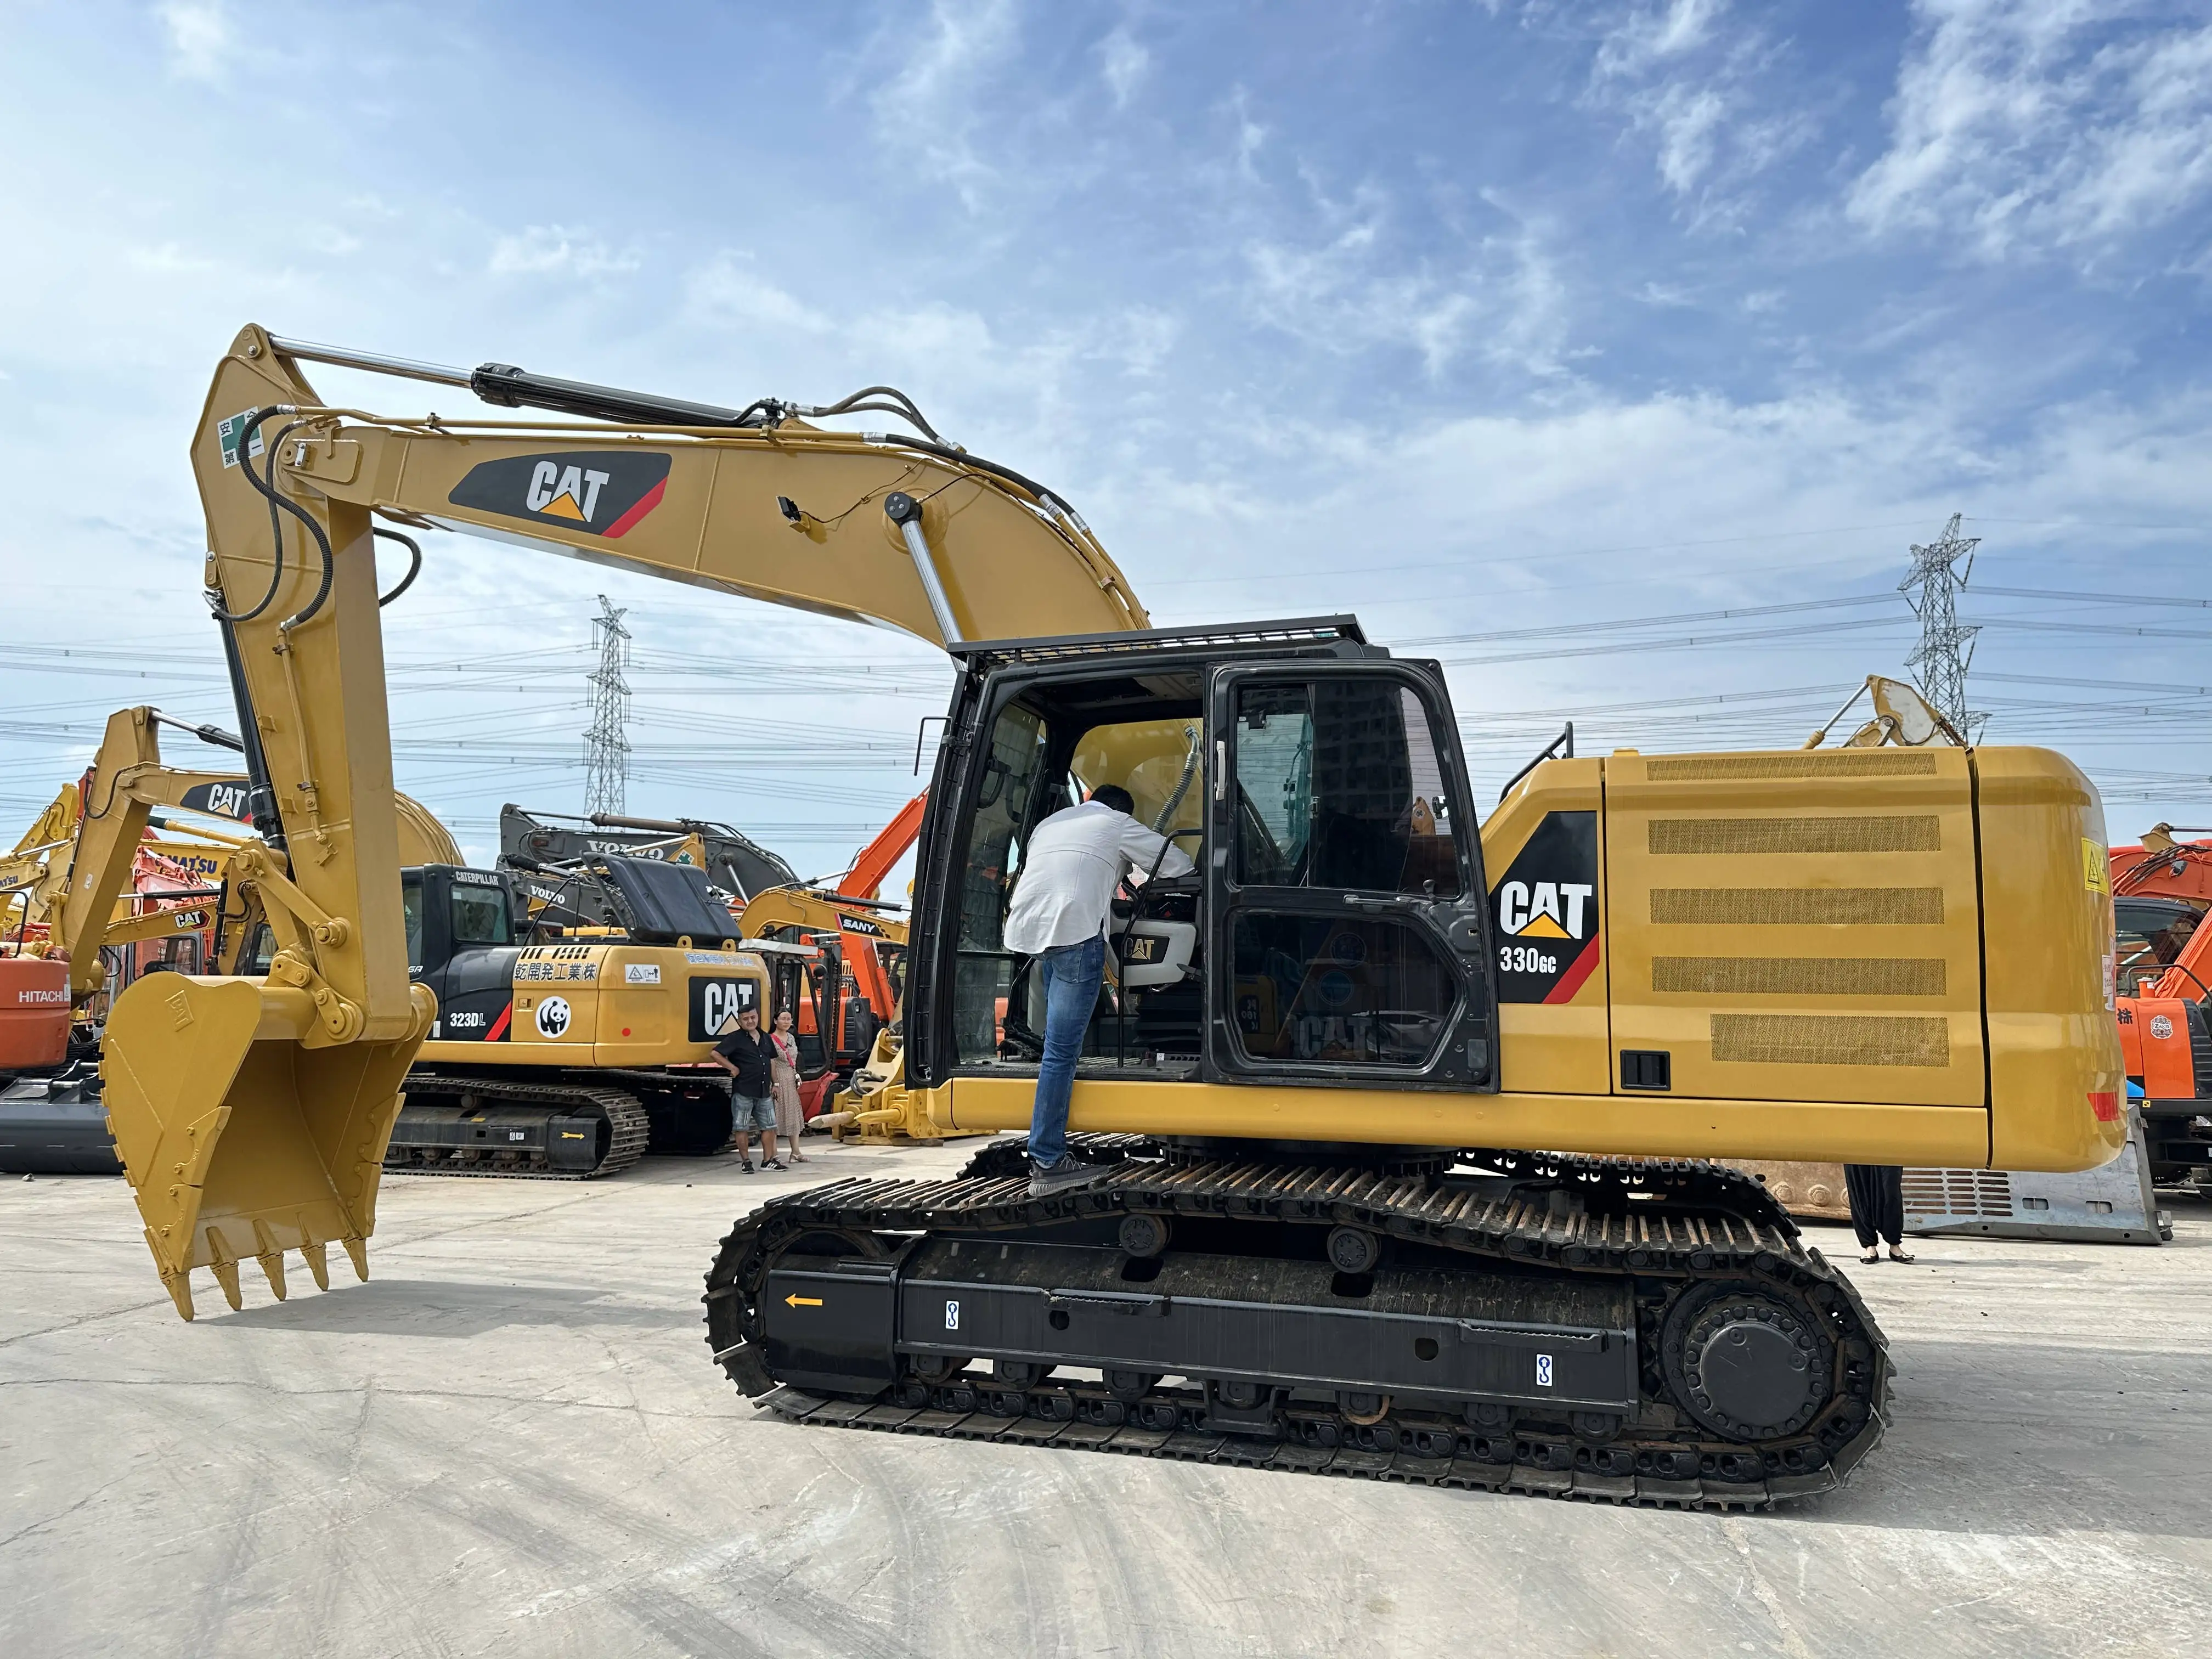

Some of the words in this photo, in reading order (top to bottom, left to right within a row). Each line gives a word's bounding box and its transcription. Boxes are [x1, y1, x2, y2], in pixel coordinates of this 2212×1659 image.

[526, 461, 610, 523] CAT
[208, 783, 246, 817] CAT
[455, 871, 499, 886] CATERPILLAR
[531, 884, 565, 904] VOLVO
[174, 911, 201, 928] CAT
[1500, 881, 1593, 939] CAT
[843, 918, 876, 933] SANY
[1124, 938, 1155, 960] CAT
[1500, 946, 1556, 974] 330GC
[19, 990, 63, 1003] HITACHI
[450, 1012, 486, 1027] 323DL
[704, 983, 753, 1036] CAT
